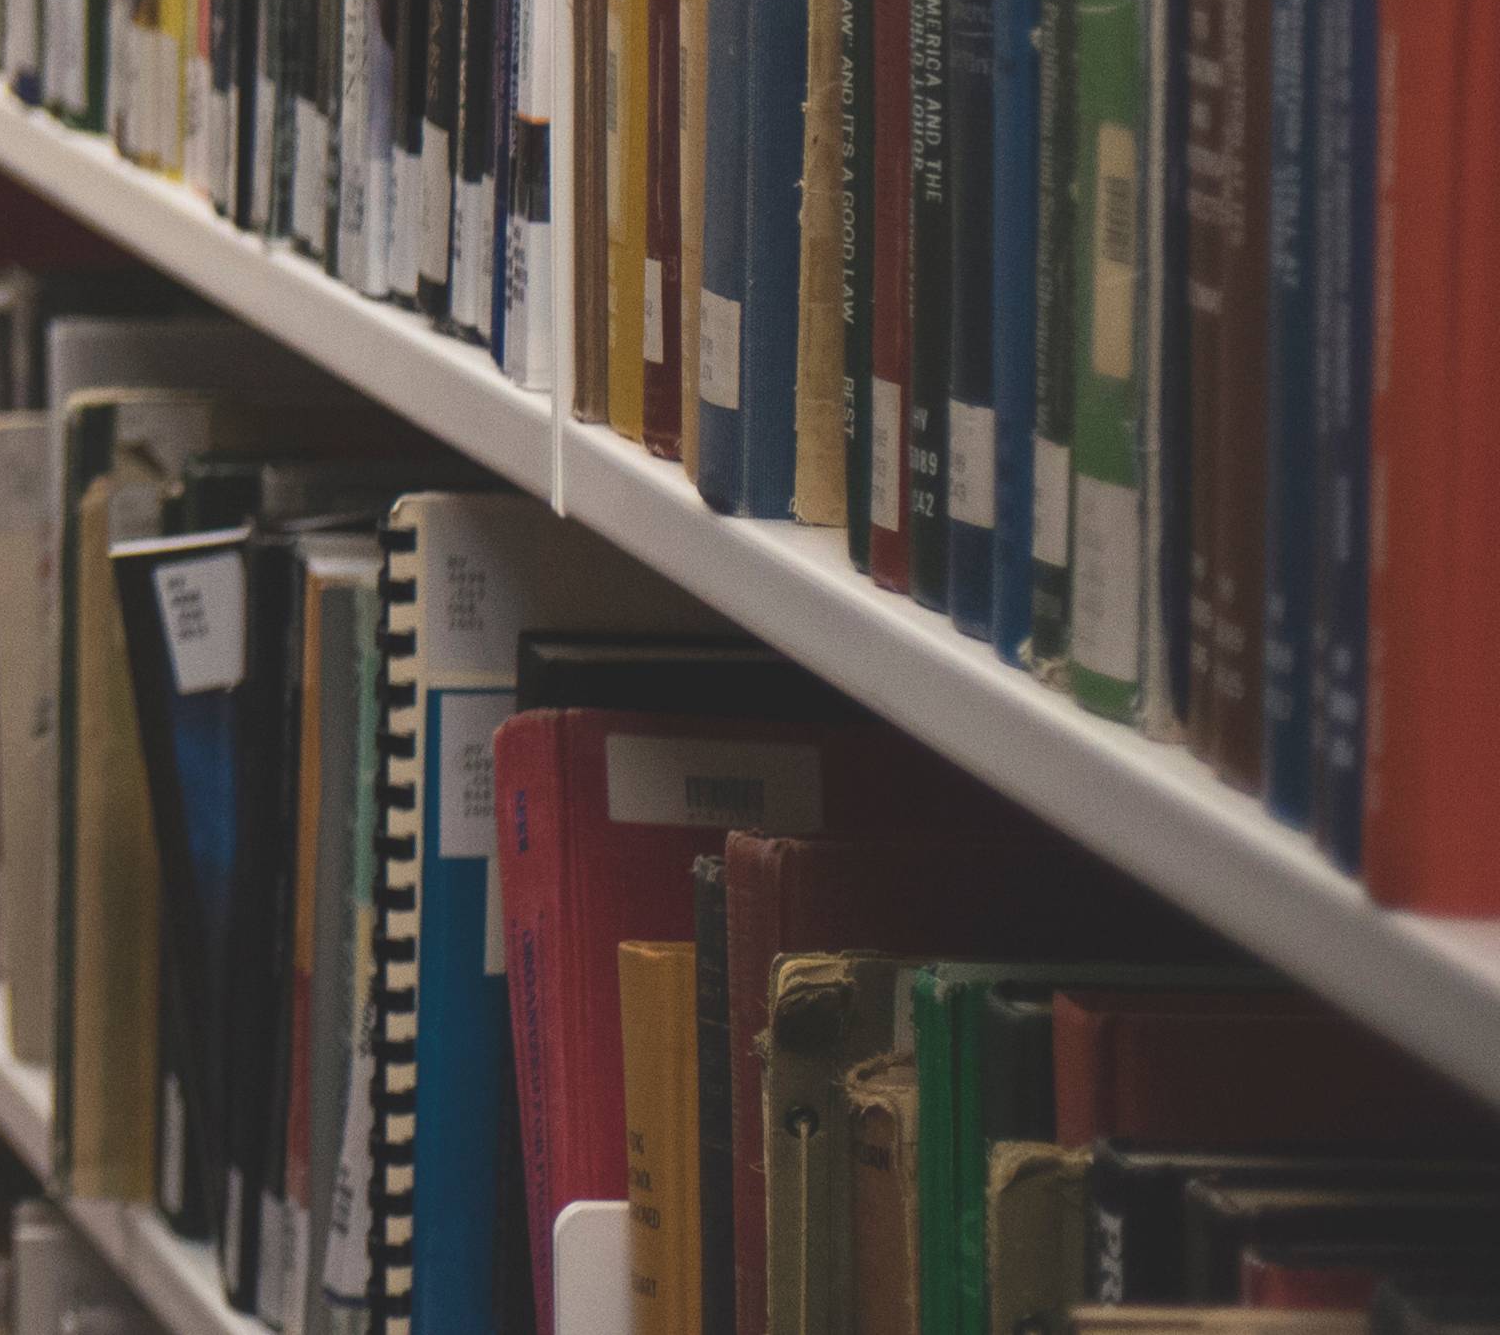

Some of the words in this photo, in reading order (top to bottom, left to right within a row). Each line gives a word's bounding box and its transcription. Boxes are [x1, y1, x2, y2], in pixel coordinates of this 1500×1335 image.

[840, 54, 856, 105] AND
[841, 113, 857, 161] IT'S
[925, 96, 942, 147] AND
[841, 166, 856, 184] A
[924, 158, 942, 204] THE
[841, 189, 857, 260] GOOD
[842, 267, 857, 325] LAW
